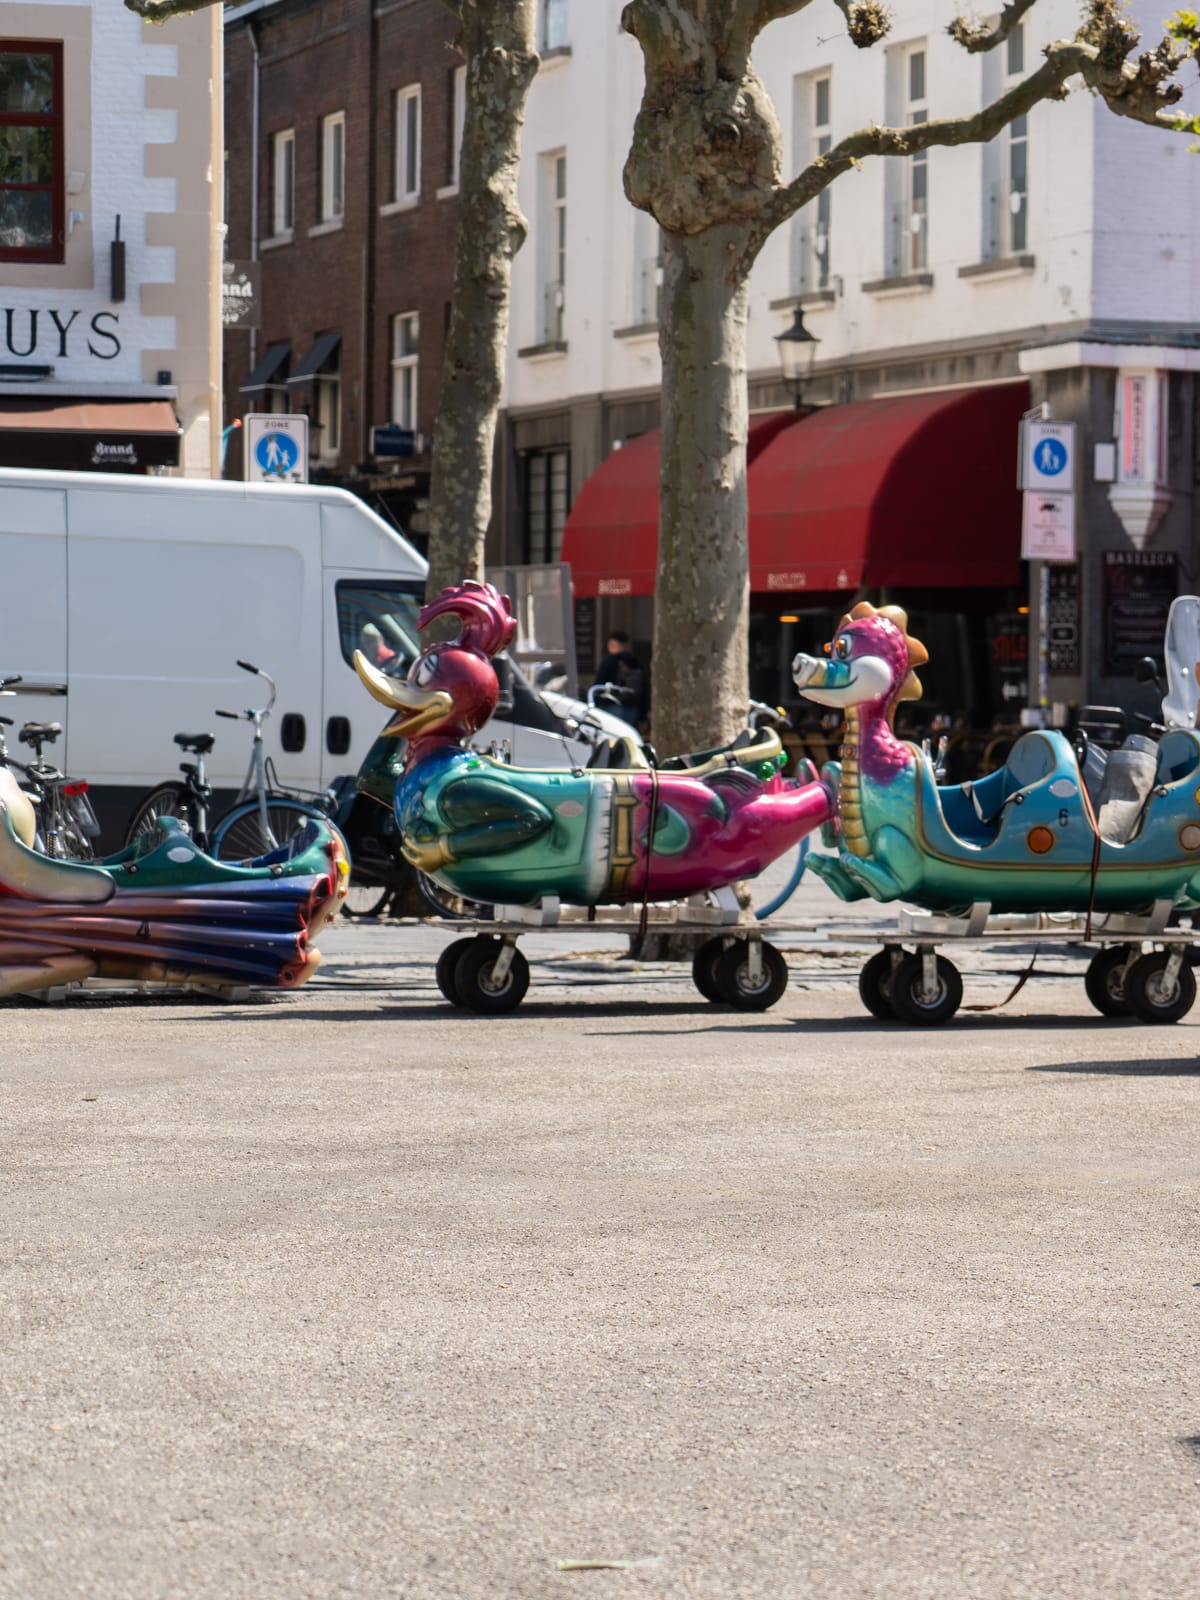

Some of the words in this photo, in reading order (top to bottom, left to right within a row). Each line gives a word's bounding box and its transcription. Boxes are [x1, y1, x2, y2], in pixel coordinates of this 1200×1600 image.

[4, 308, 121, 360] UYS
[264, 421, 289, 429] ZONE
[95, 441, 134, 456] Brand
[1058, 807, 1069, 828] 6
[135, 919, 151, 941] 4
